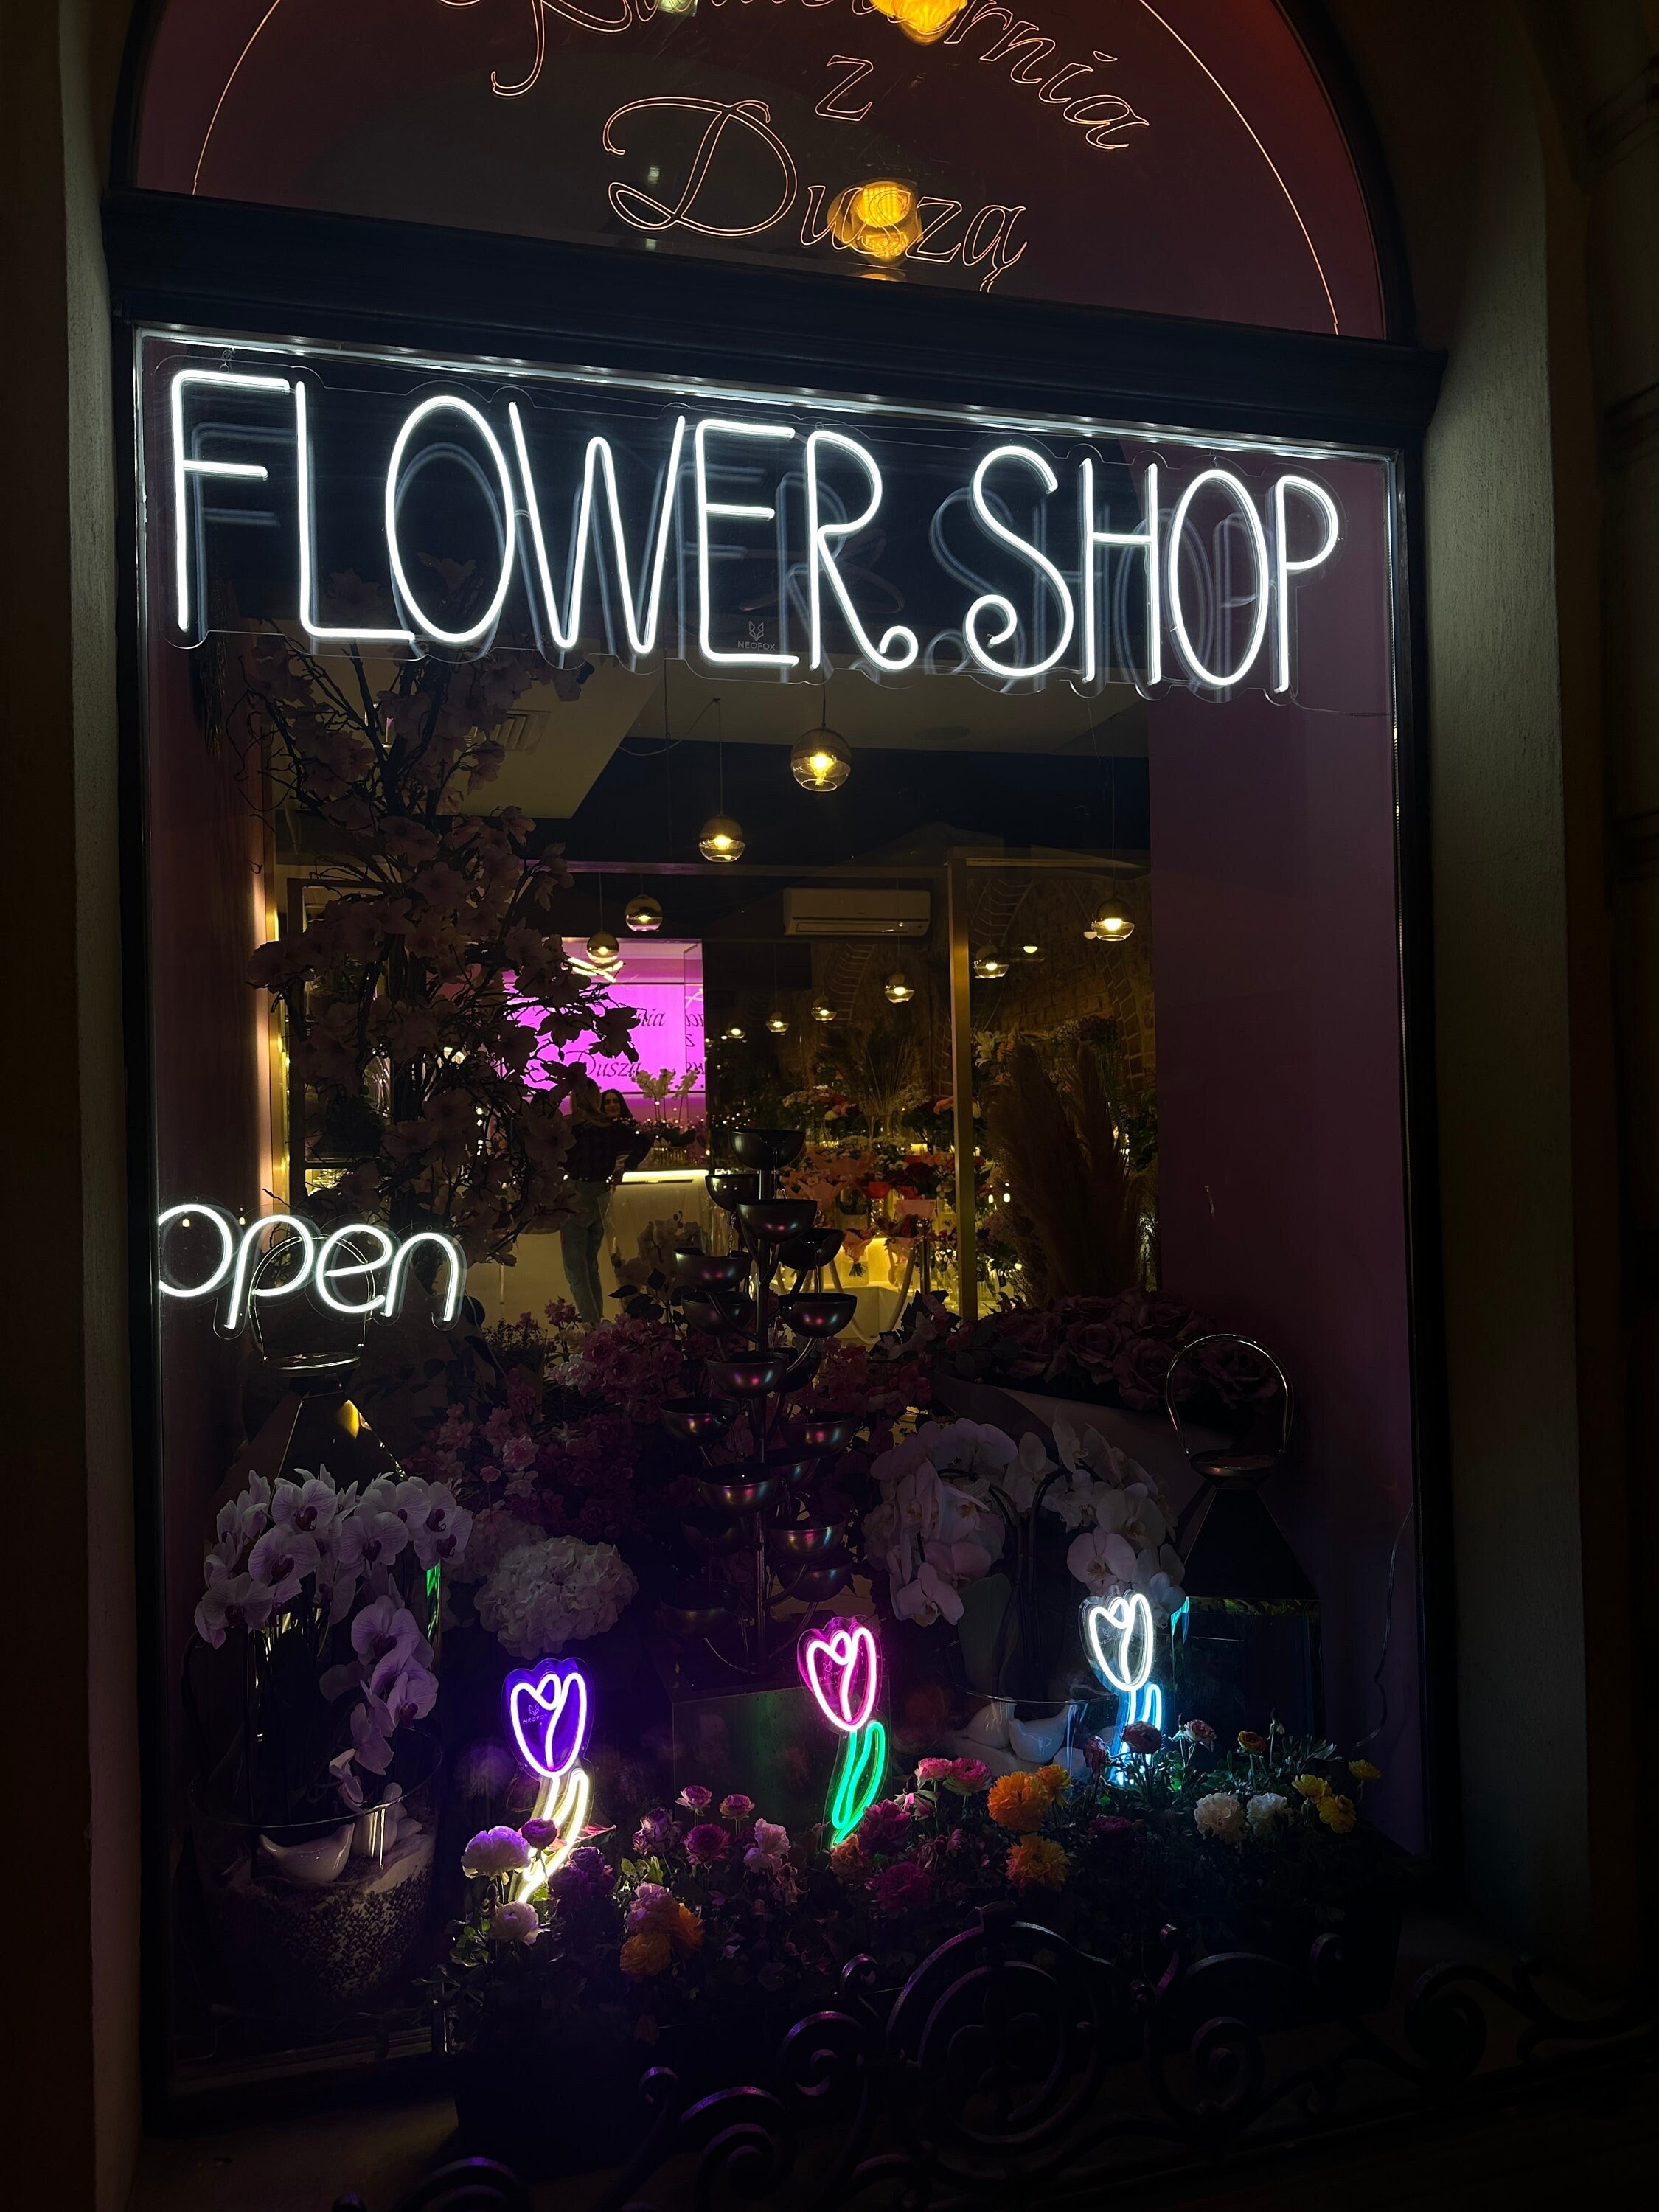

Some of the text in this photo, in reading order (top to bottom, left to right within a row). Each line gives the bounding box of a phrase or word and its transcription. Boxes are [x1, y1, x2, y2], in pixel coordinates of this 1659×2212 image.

[815, 55, 874, 122] z
[602, 96, 1028, 293] Duszą
[171, 369, 1339, 693] FLOWER SHOP
[737, 640, 776, 650] NEOFOX
[158, 1203, 460, 1330] open
